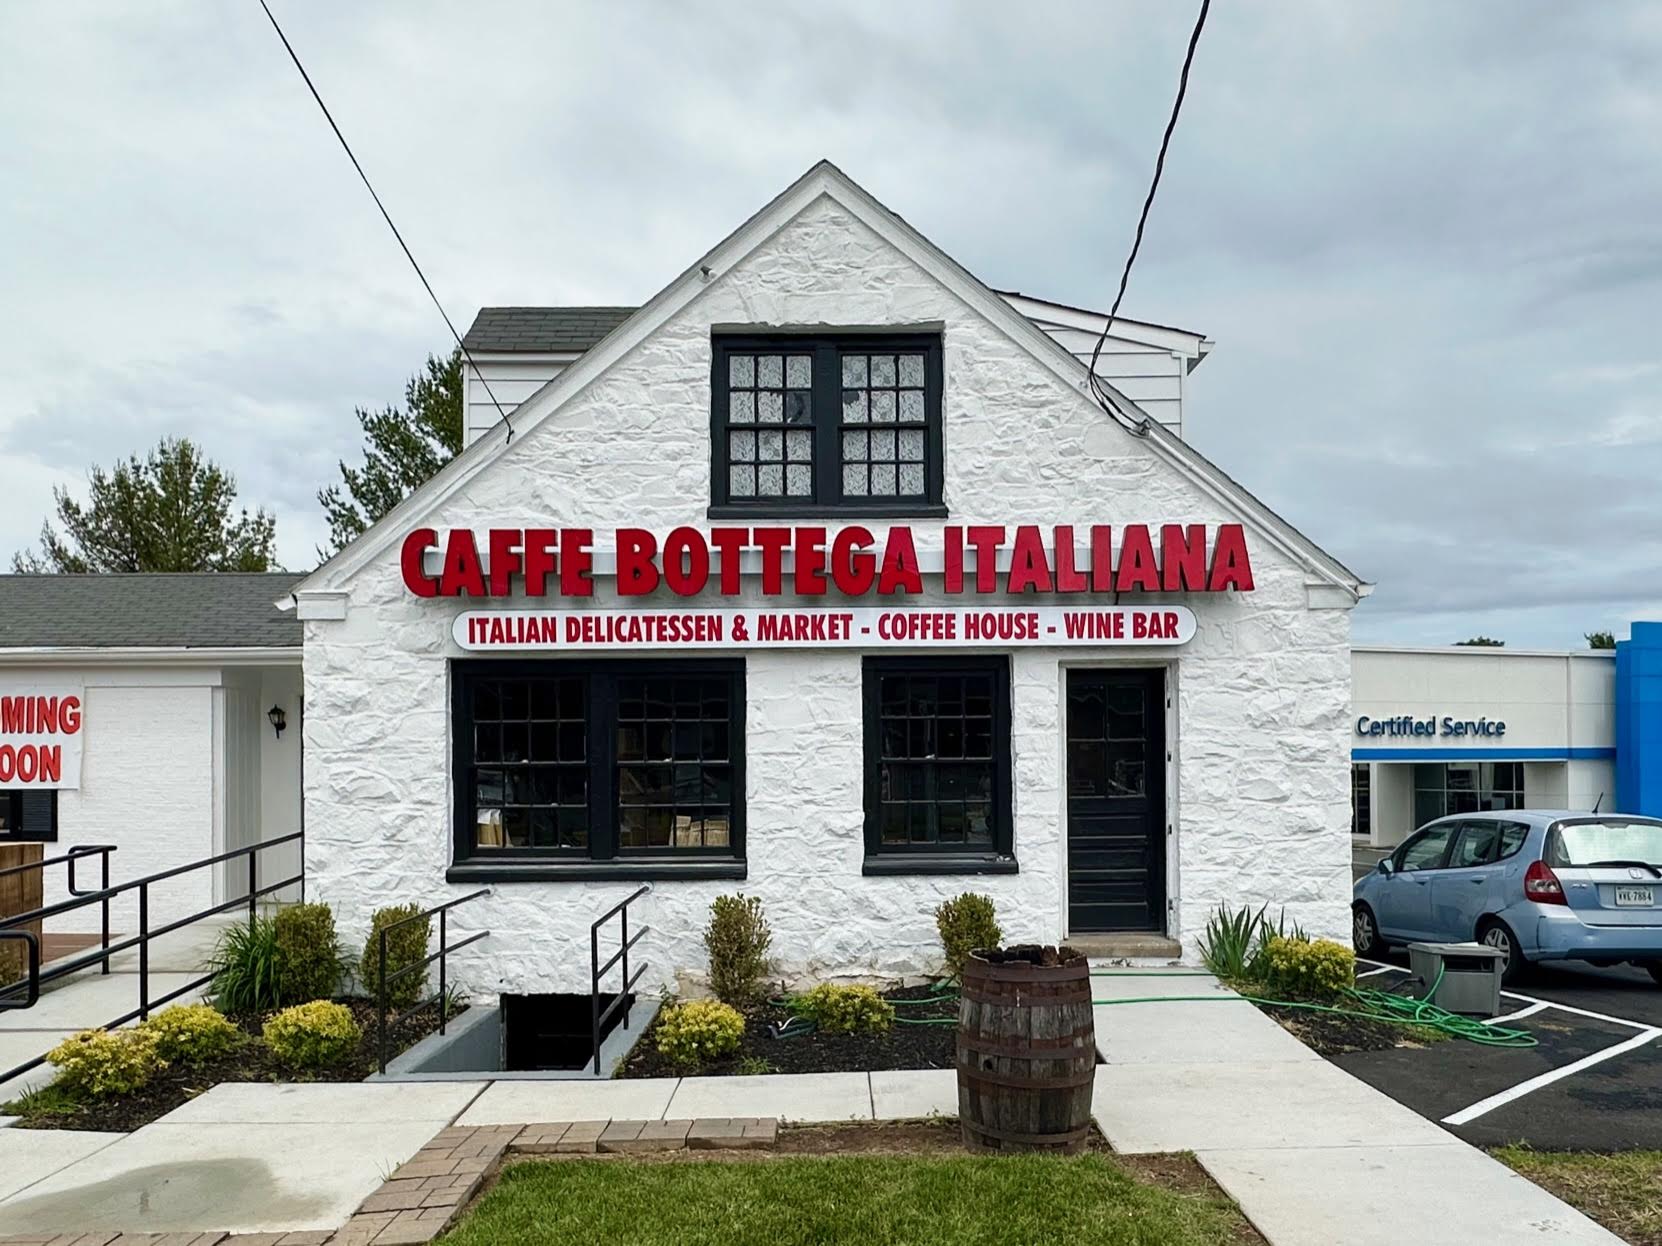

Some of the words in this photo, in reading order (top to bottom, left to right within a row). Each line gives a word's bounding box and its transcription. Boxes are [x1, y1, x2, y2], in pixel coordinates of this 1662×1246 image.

[400, 527, 593, 598] CAFFE
[615, 526, 923, 597] BOTTEGA
[944, 523, 1254, 594] ITALIANA
[468, 616, 557, 644] ITALIAN
[565, 615, 723, 643] DELICATESSEN
[731, 614, 749, 642] &
[757, 613, 853, 641] MARKET
[877, 612, 956, 640] COFFEE
[964, 612, 1039, 640] HOUSE
[1063, 611, 1124, 639] WINE
[1132, 611, 1178, 639] BAR
[1356, 716, 1436, 737] Certified
[1441, 717, 1506, 737] Service
